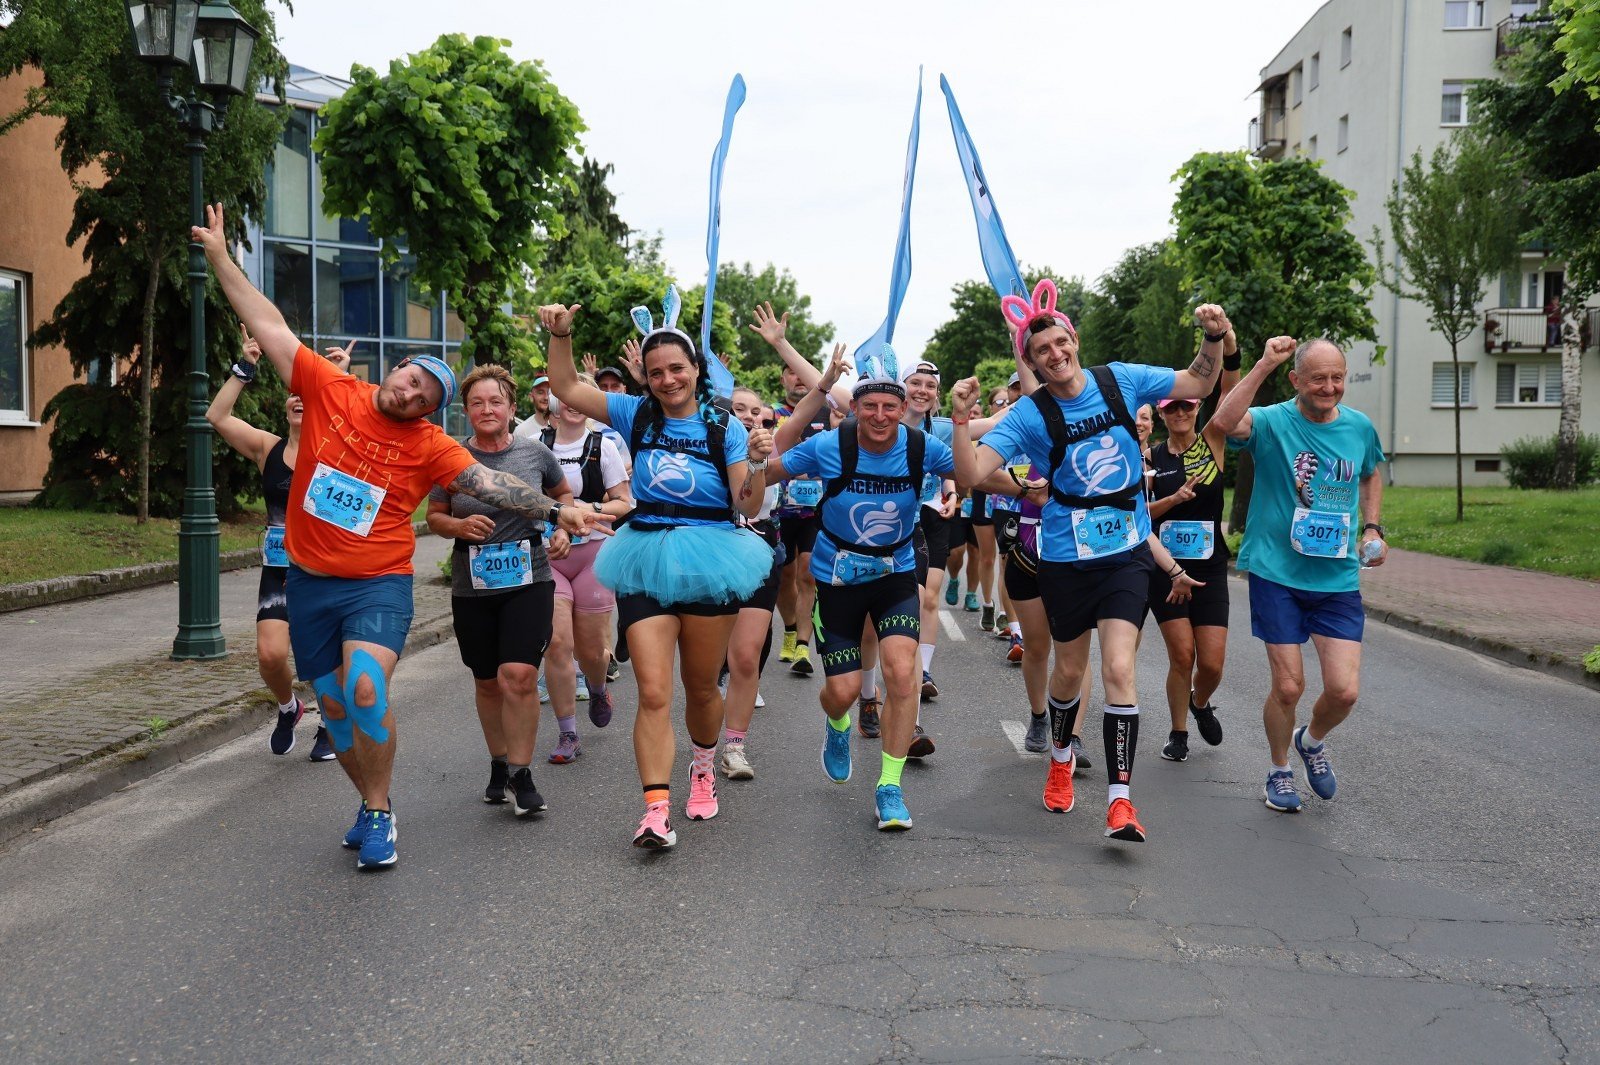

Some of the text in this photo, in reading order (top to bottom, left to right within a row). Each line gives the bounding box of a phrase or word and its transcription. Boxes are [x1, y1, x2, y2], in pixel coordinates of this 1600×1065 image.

[1323, 457, 1355, 483] XIV
[326, 486, 364, 512] 1433
[797, 487, 818, 496] 2304
[1096, 518, 1122, 536] 124
[1307, 525, 1340, 540] 3071
[1175, 533, 1199, 544] 507
[485, 555, 520, 572] 2010
